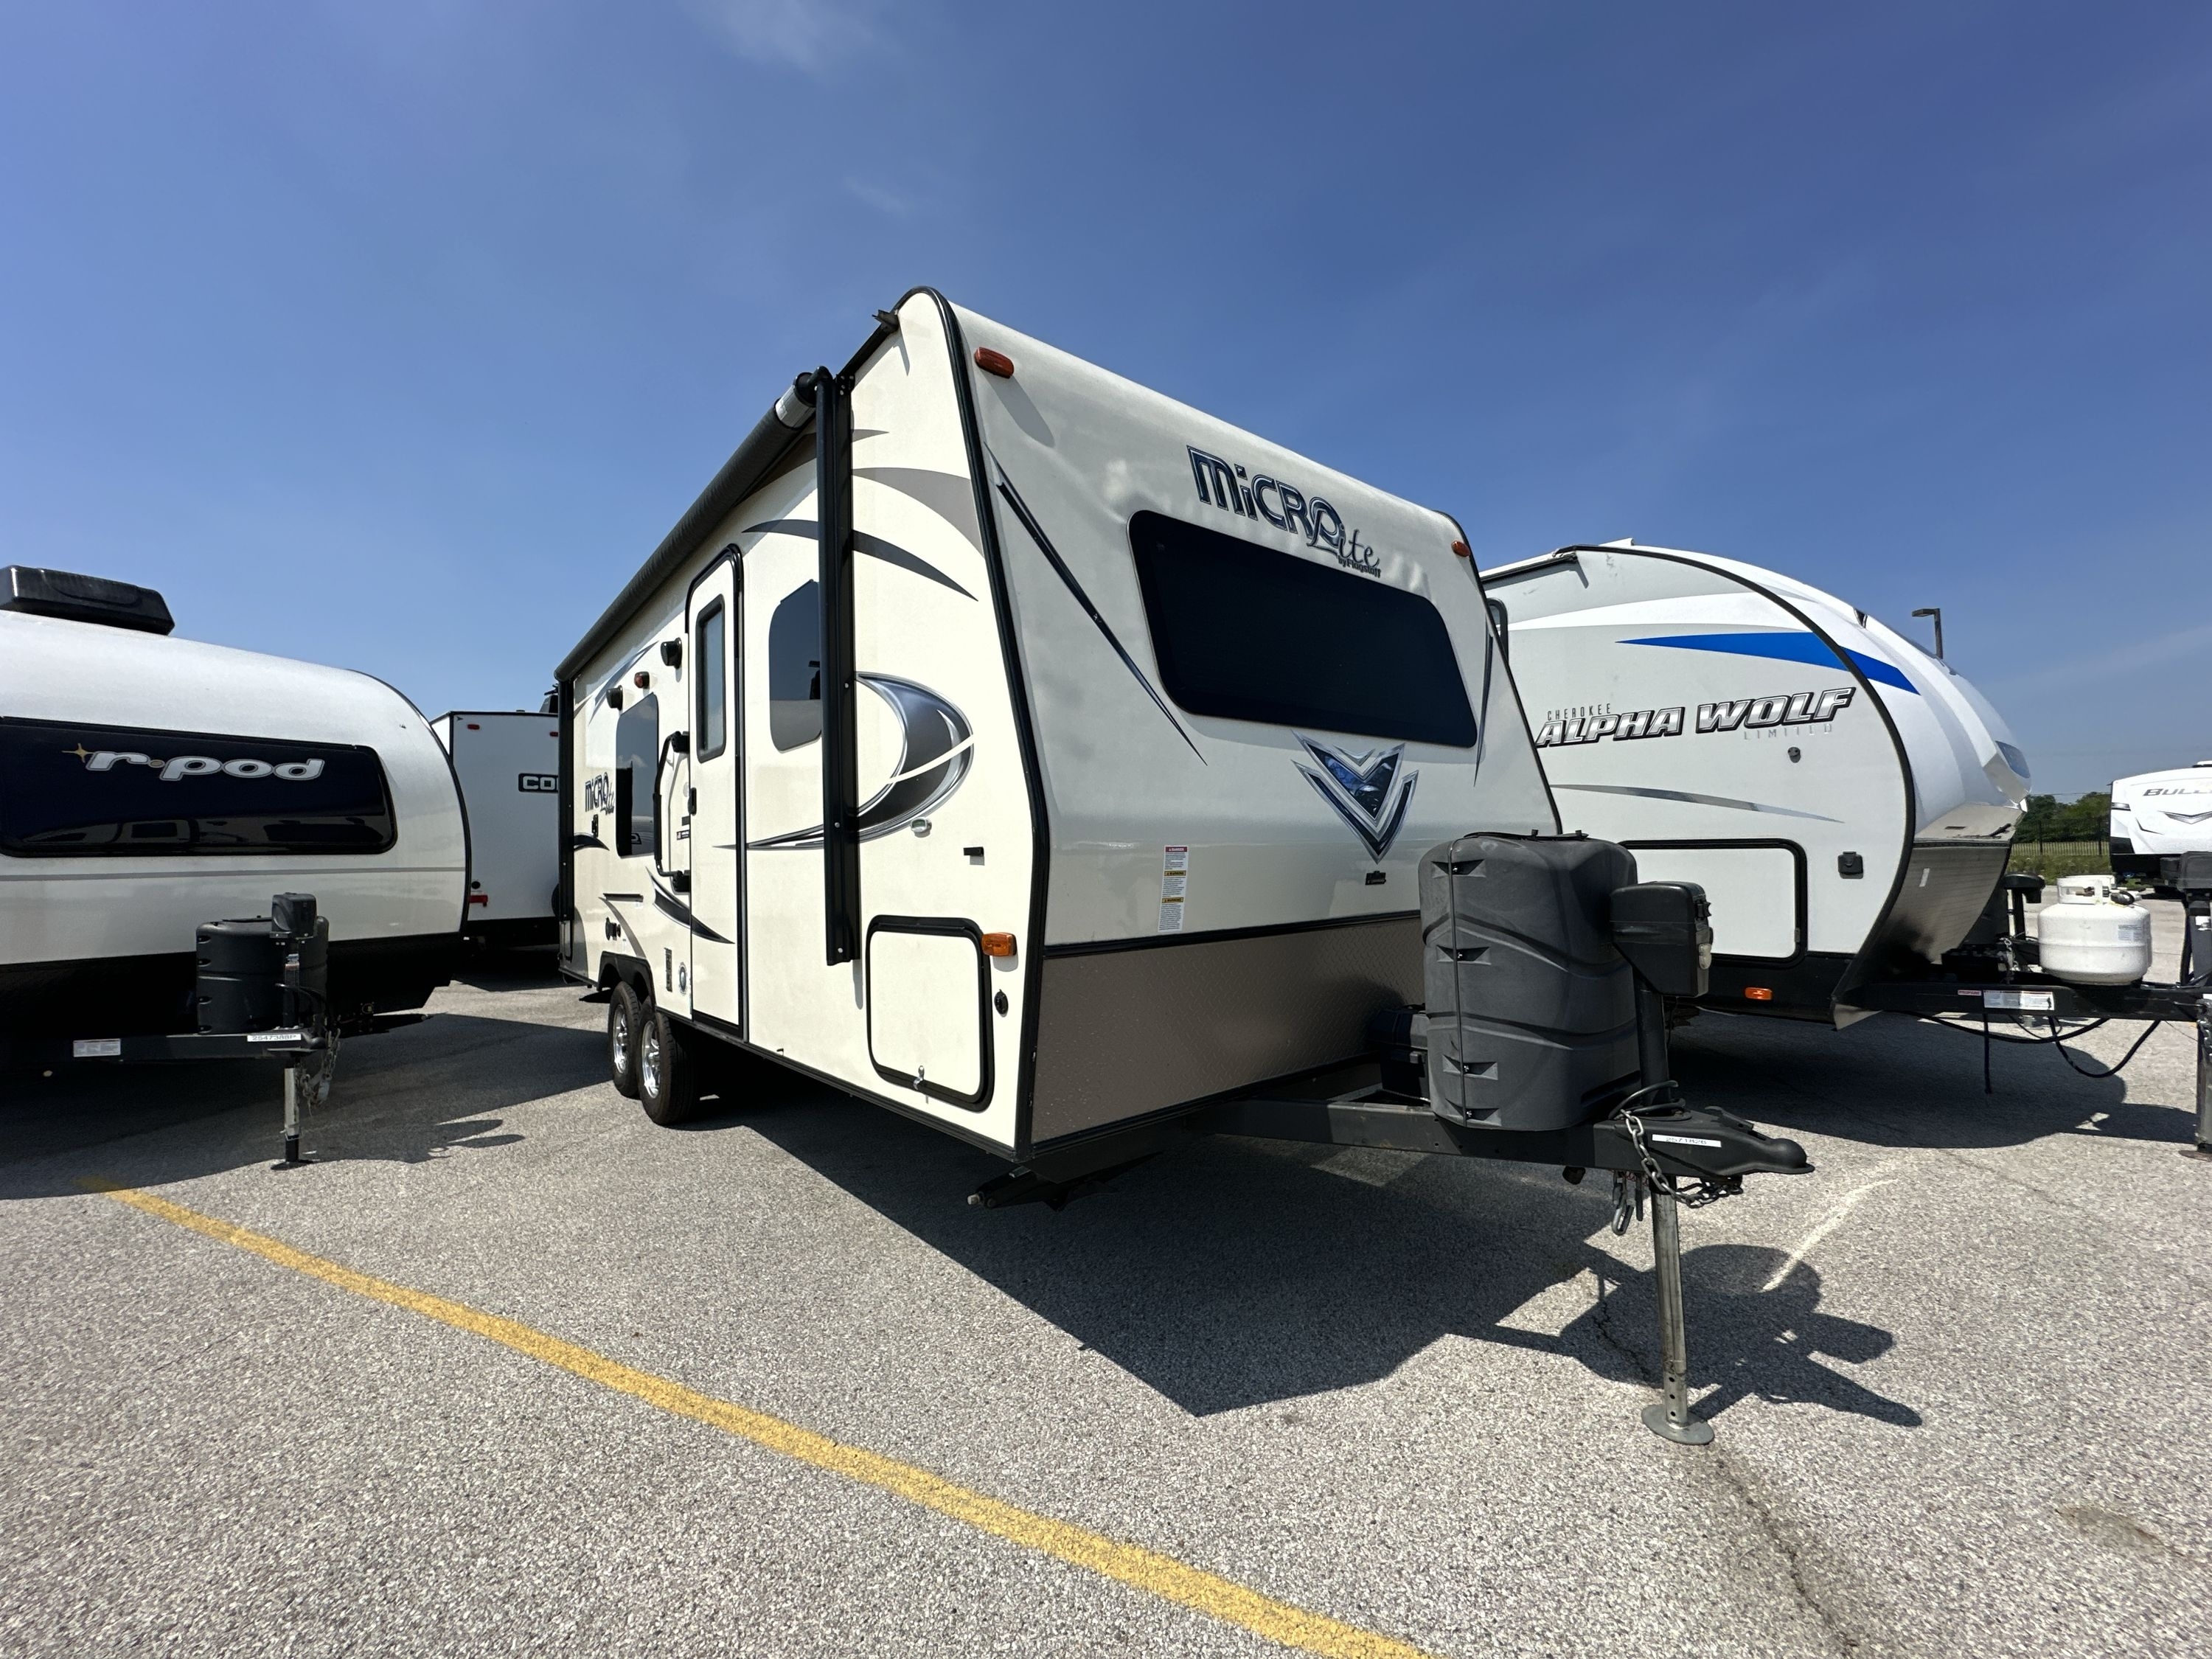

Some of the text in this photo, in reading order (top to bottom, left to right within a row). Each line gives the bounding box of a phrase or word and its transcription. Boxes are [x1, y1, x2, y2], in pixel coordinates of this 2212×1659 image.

[1535, 686, 1857, 748] ALPHA WOLF
[1547, 703, 1611, 721] CHEROKEE
[1744, 723, 1832, 740] LIMITED
[522, 775, 559, 791] CO
[2143, 788, 2212, 797] BULL
